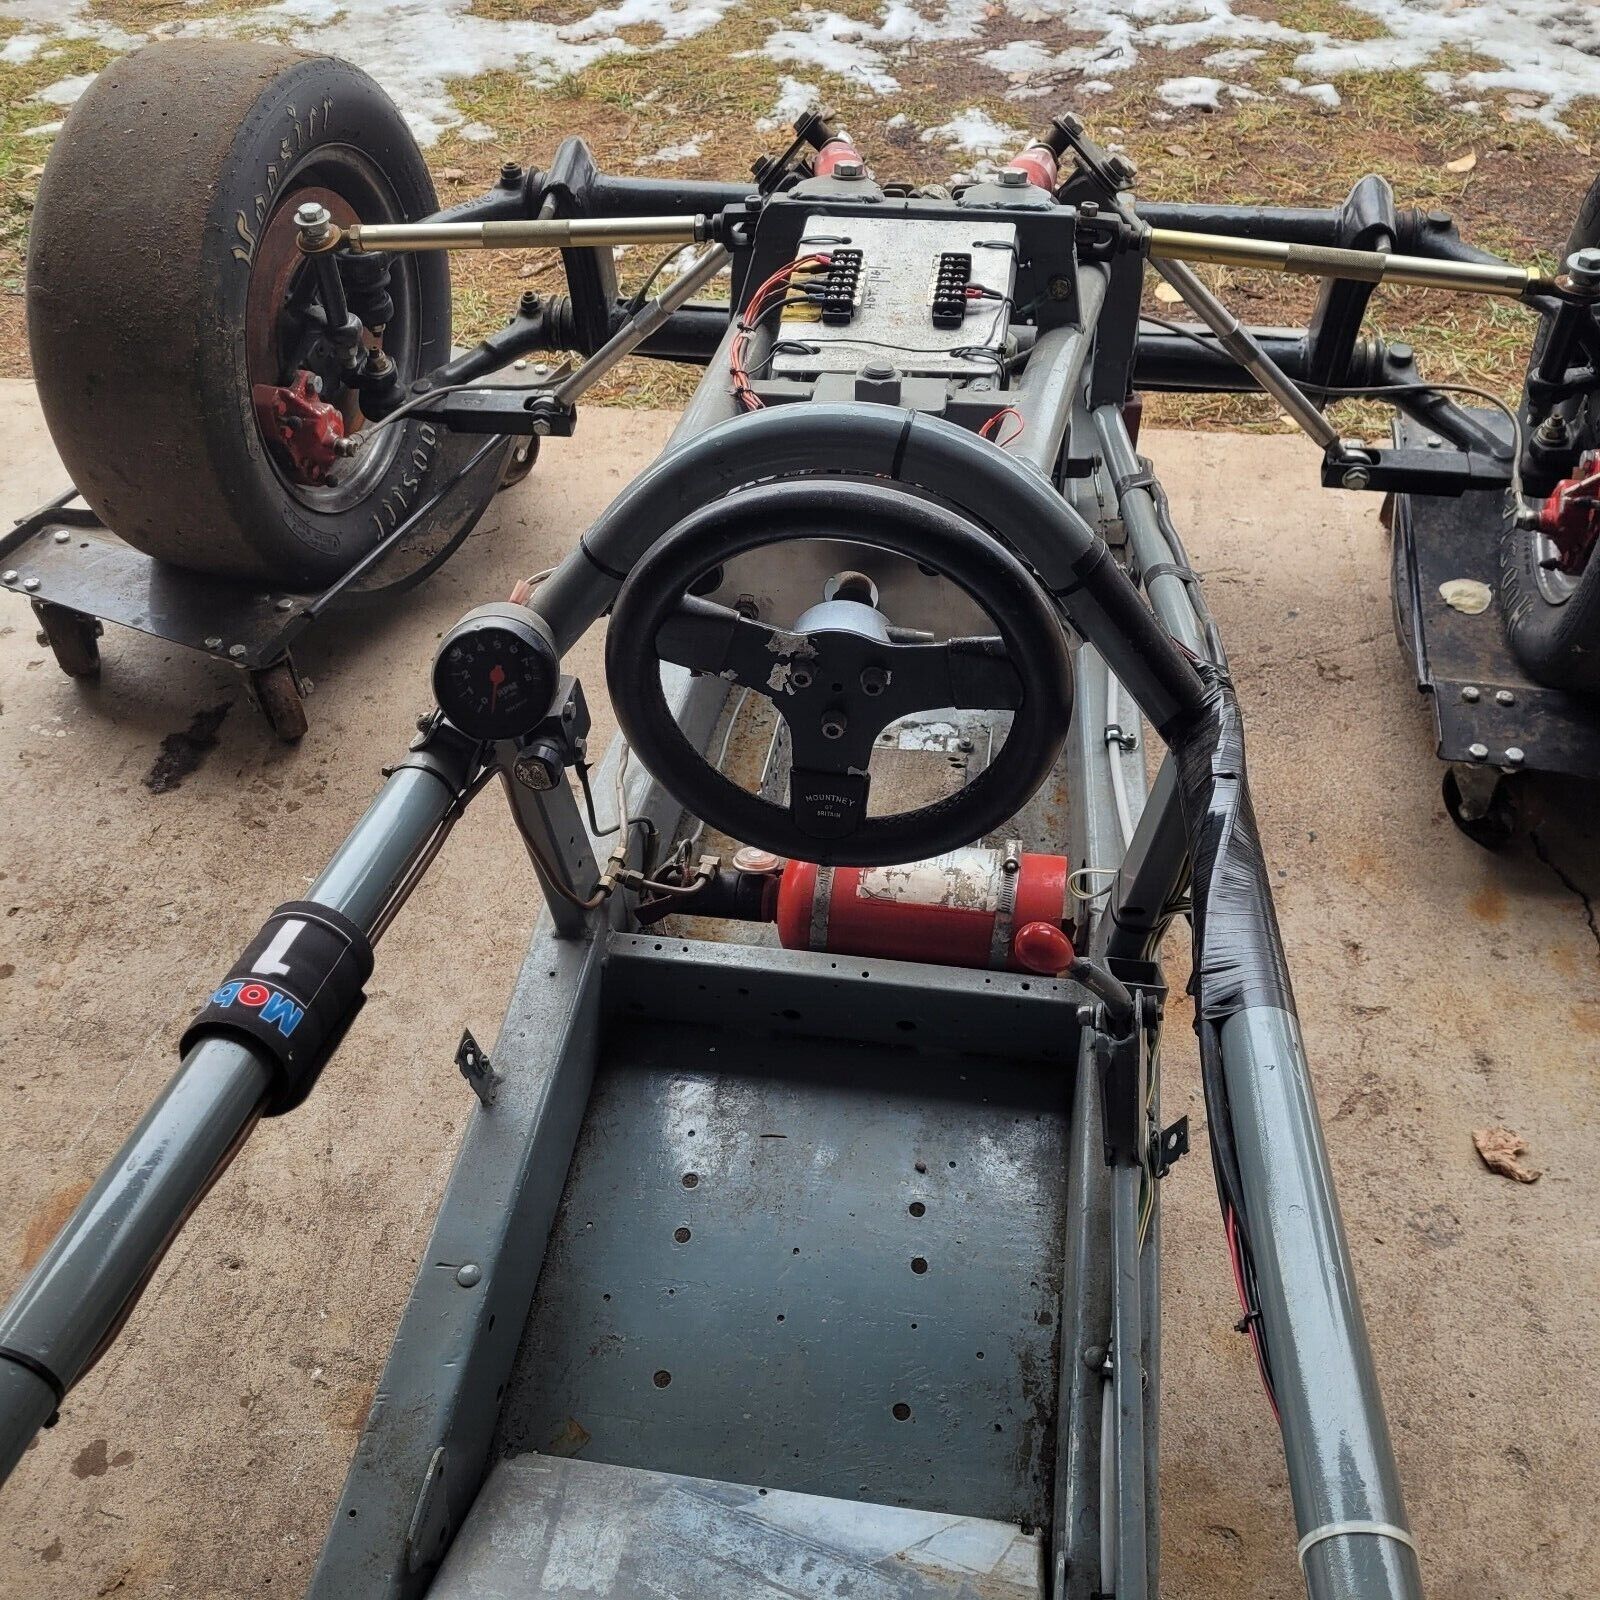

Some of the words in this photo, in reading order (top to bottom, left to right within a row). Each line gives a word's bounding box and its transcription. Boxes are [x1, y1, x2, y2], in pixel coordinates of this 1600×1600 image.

[476, 643, 486, 652] 4
[509, 644, 518, 654] 6
[465, 654, 474, 663] 3
[496, 681, 519, 698] RPM
[805, 794, 856, 807] MOUNTNEY
[817, 810, 840, 818] BRITAIN
[251, 919, 307, 977] 1
